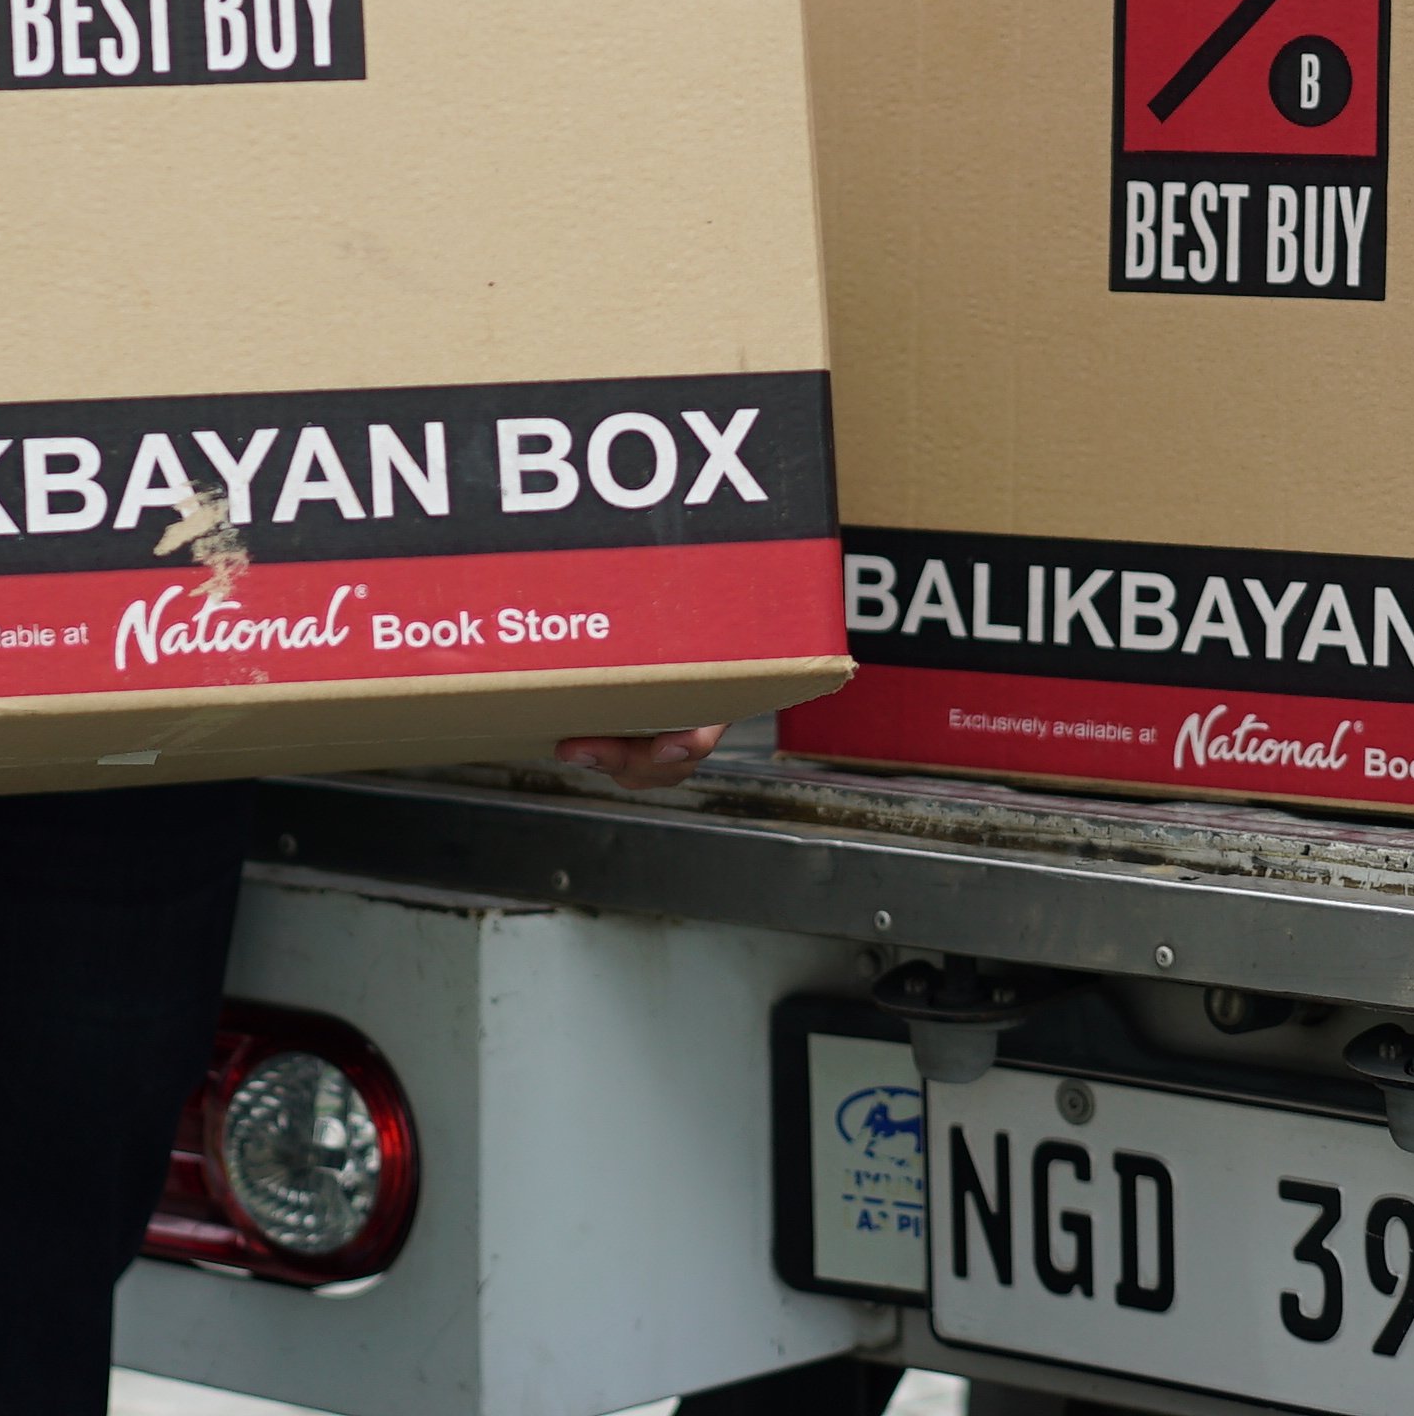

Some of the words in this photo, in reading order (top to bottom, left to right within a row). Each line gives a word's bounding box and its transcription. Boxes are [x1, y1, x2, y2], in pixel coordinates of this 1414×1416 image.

[1300, 53, 1321, 109] B
[1125, 181, 1250, 282] BEST
[1266, 184, 1371, 287] BUY
[496, 408, 768, 513] BOX
[63, 622, 89, 645] at
[115, 585, 351, 670] National
[372, 611, 484, 650] Book
[498, 608, 610, 643] Store
[949, 708, 1046, 738] Exclusively
[1052, 720, 1132, 741] available
[1139, 726, 1157, 744] at
[1173, 704, 1352, 770] National
[950, 1124, 1175, 1313] NGD
